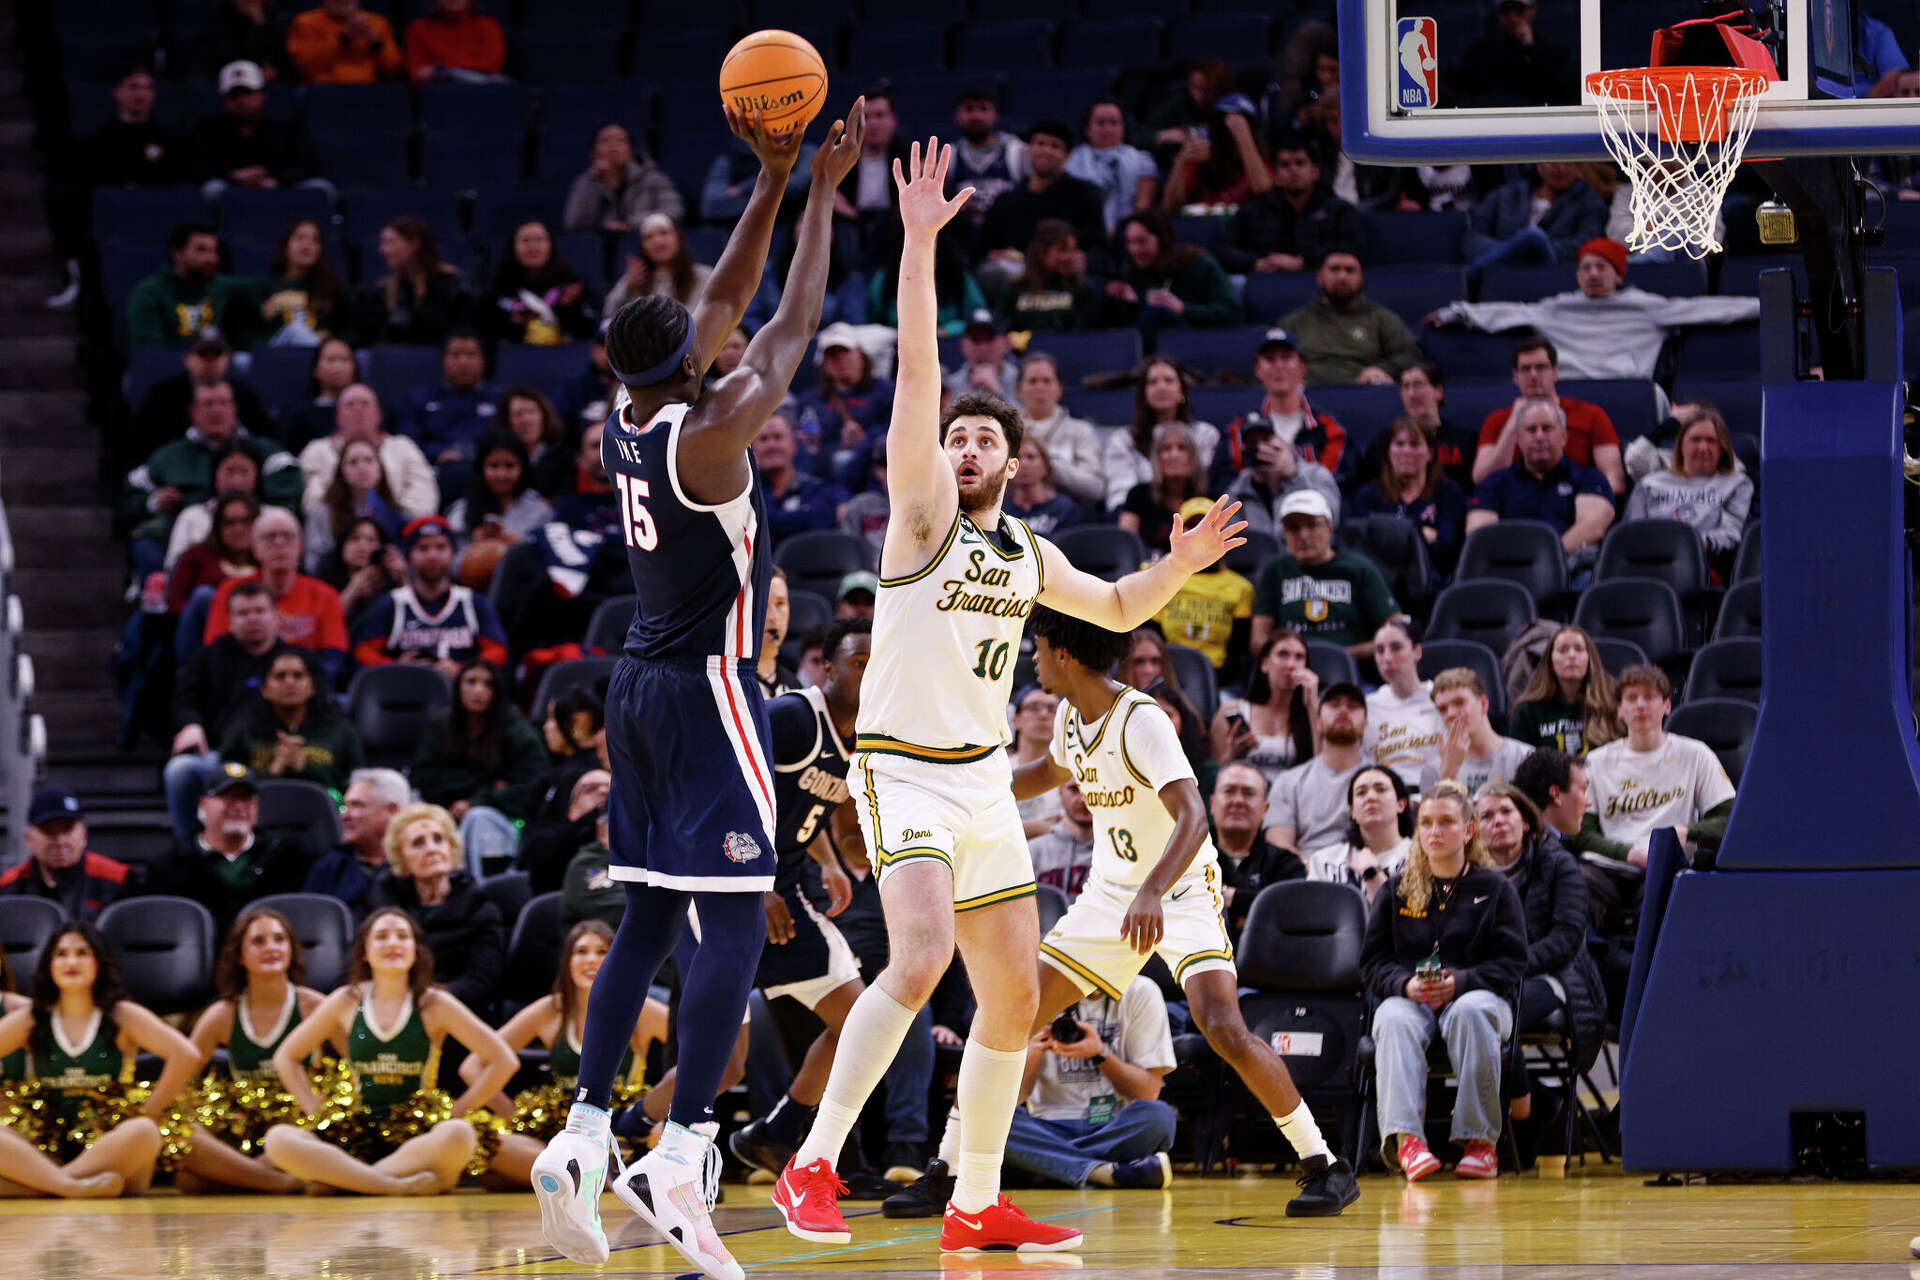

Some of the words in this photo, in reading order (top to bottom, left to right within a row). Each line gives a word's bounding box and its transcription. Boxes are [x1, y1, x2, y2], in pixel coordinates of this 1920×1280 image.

[733, 90, 805, 113] Wilson
[1402, 88, 1422, 104] NBA
[615, 438, 642, 465] IKE
[615, 471, 659, 552] 15
[965, 549, 1011, 588] San
[972, 637, 1010, 682] 10
[1074, 753, 1099, 783] San
[1082, 785, 1135, 808] ancisco
[796, 803, 826, 843] 5
[902, 828, 933, 843] Dons
[1108, 826, 1138, 862] 13
